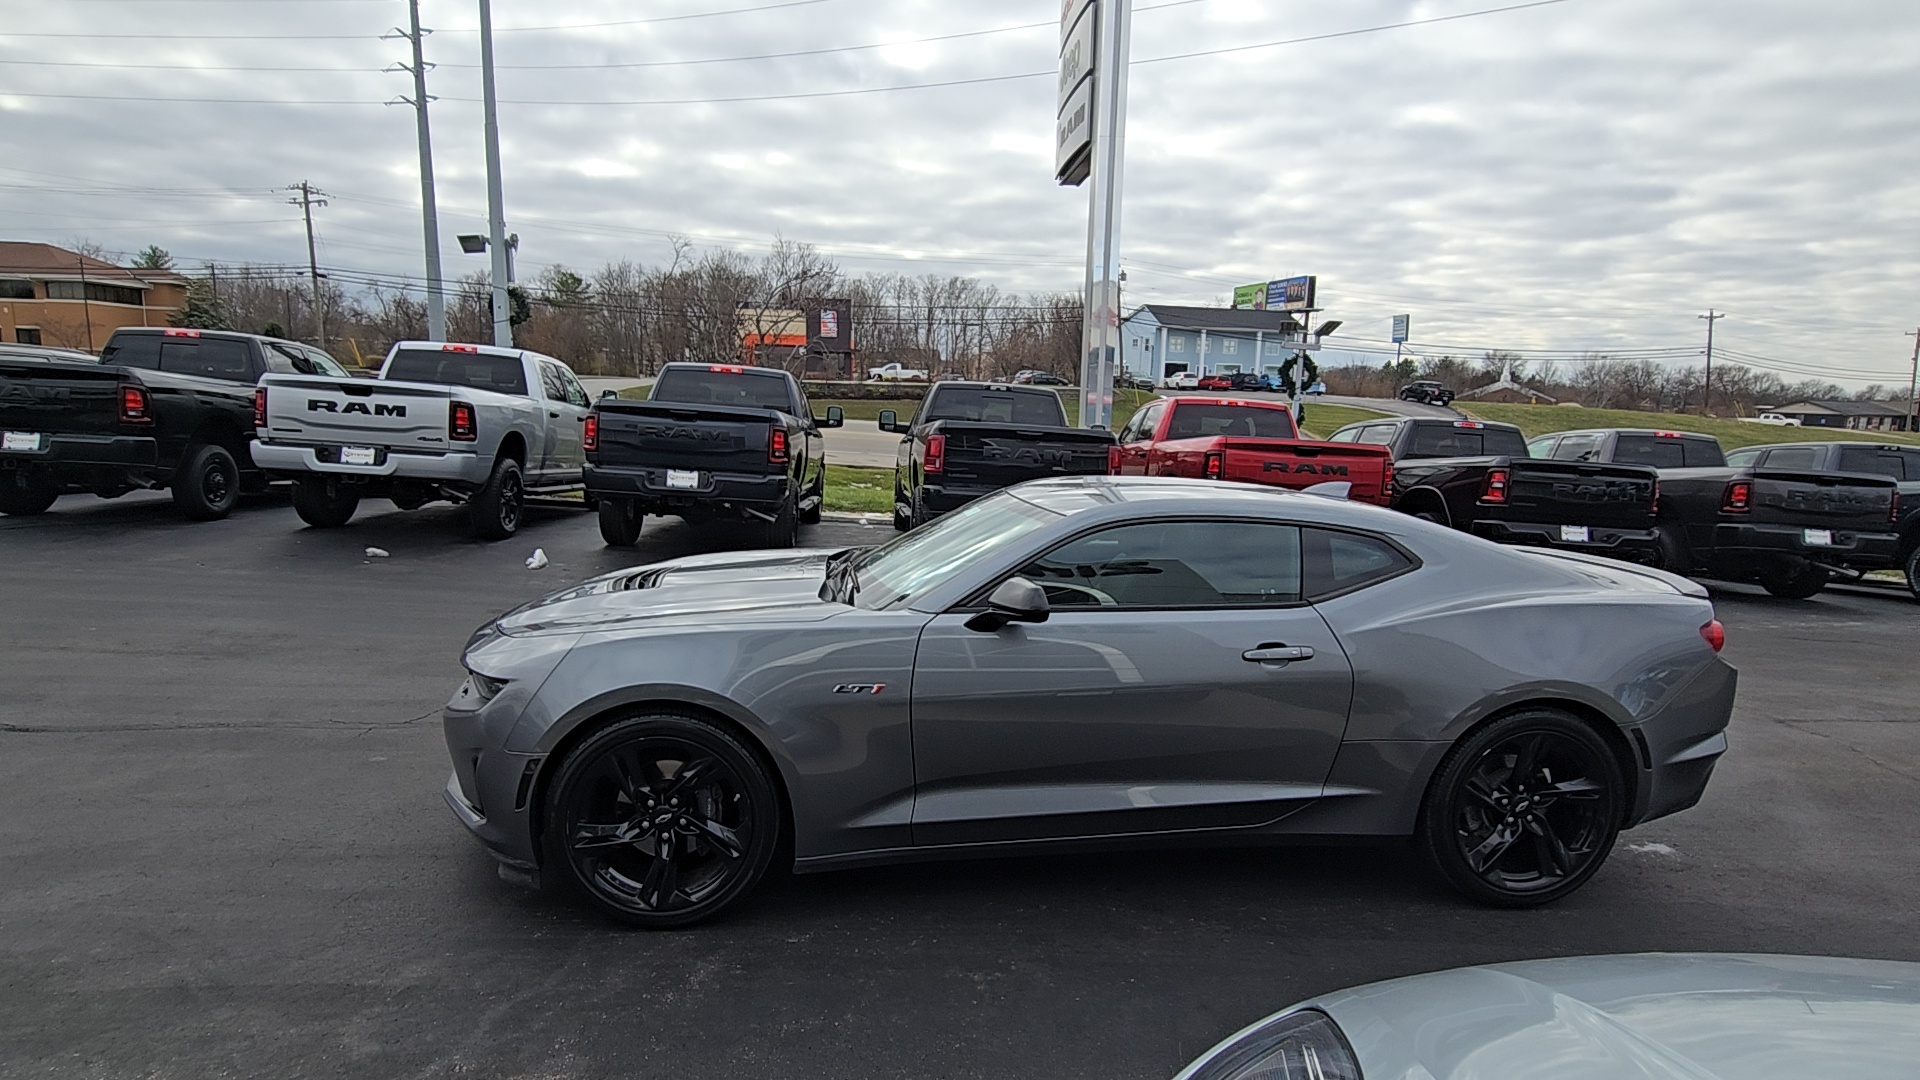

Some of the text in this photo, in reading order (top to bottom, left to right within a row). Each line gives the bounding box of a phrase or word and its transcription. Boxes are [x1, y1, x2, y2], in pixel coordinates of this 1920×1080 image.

[0, 385, 71, 400] AM
[307, 399, 407, 418] RAM
[637, 424, 731, 442] RAM
[983, 445, 1072, 462] RAM
[1263, 461, 1348, 477] RAM
